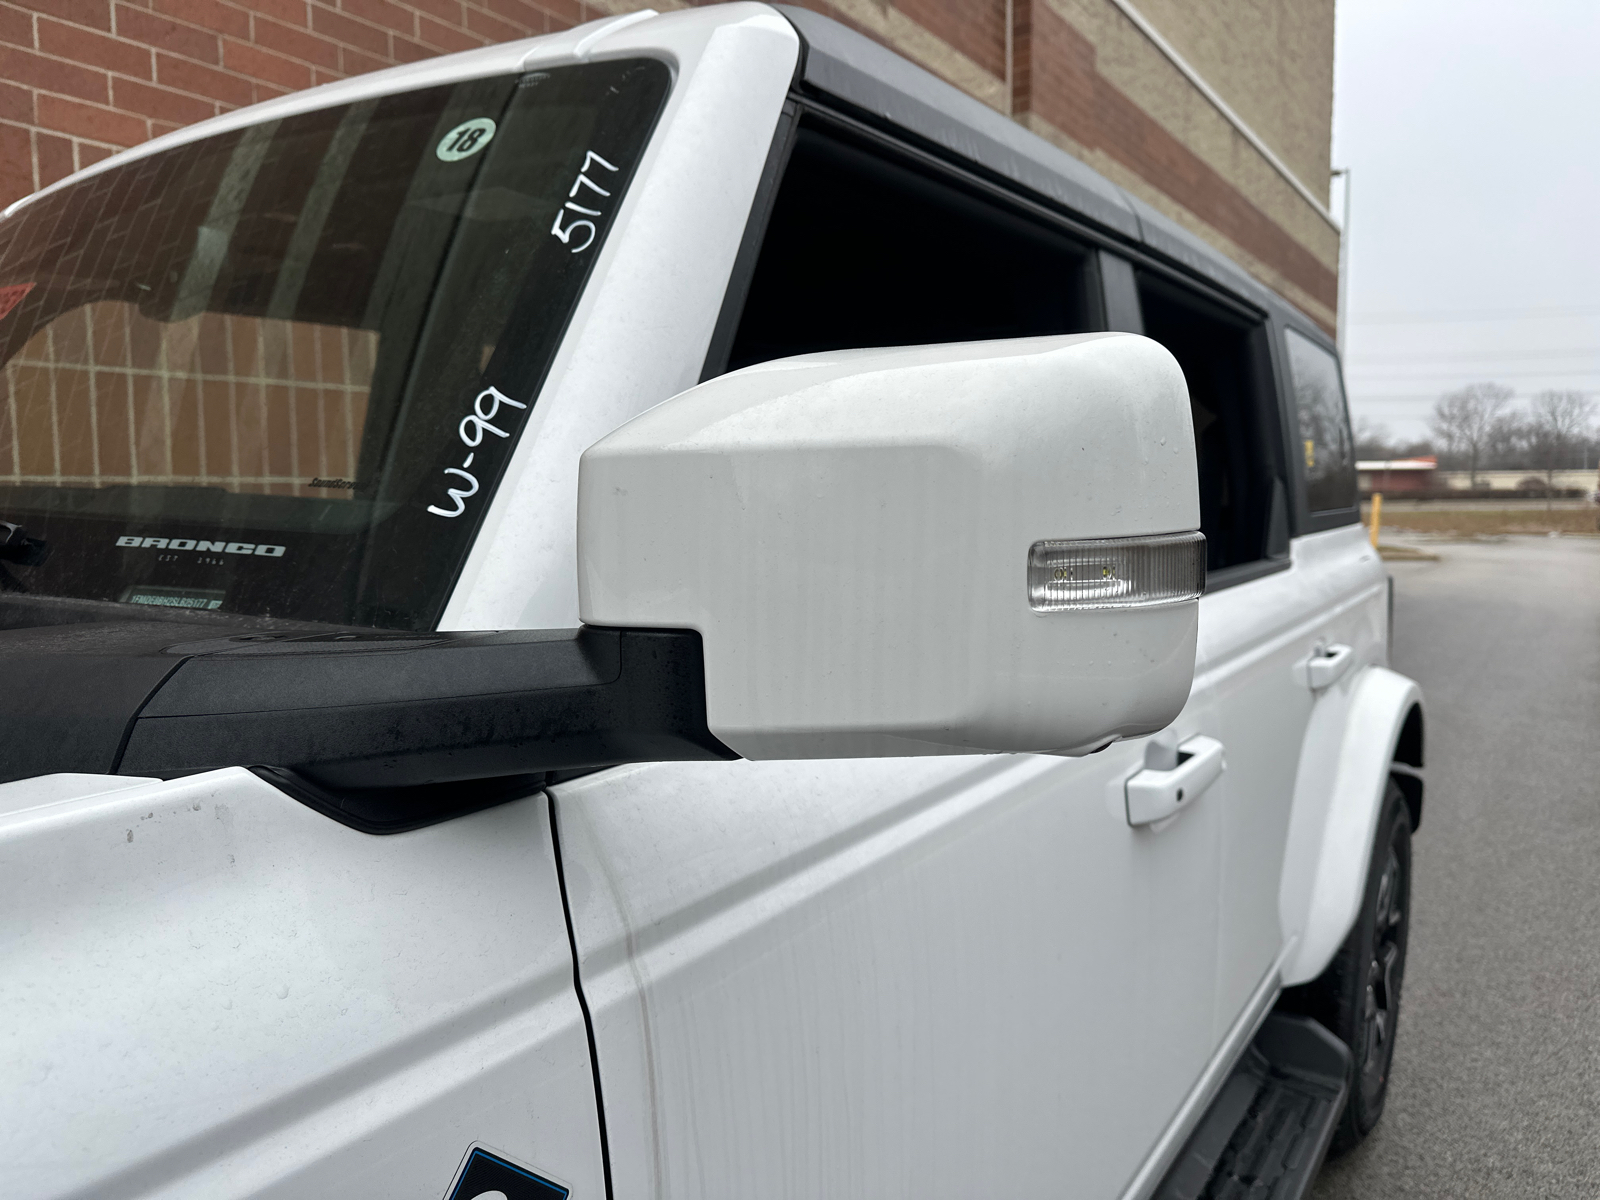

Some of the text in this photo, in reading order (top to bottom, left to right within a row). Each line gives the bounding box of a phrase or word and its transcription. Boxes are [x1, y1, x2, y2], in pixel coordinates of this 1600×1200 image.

[445, 127, 487, 152] 18
[551, 150, 619, 253] 5177
[427, 385, 527, 518] W-99
[115, 536, 287, 557] BRONCO
[158, 554, 179, 562] EST
